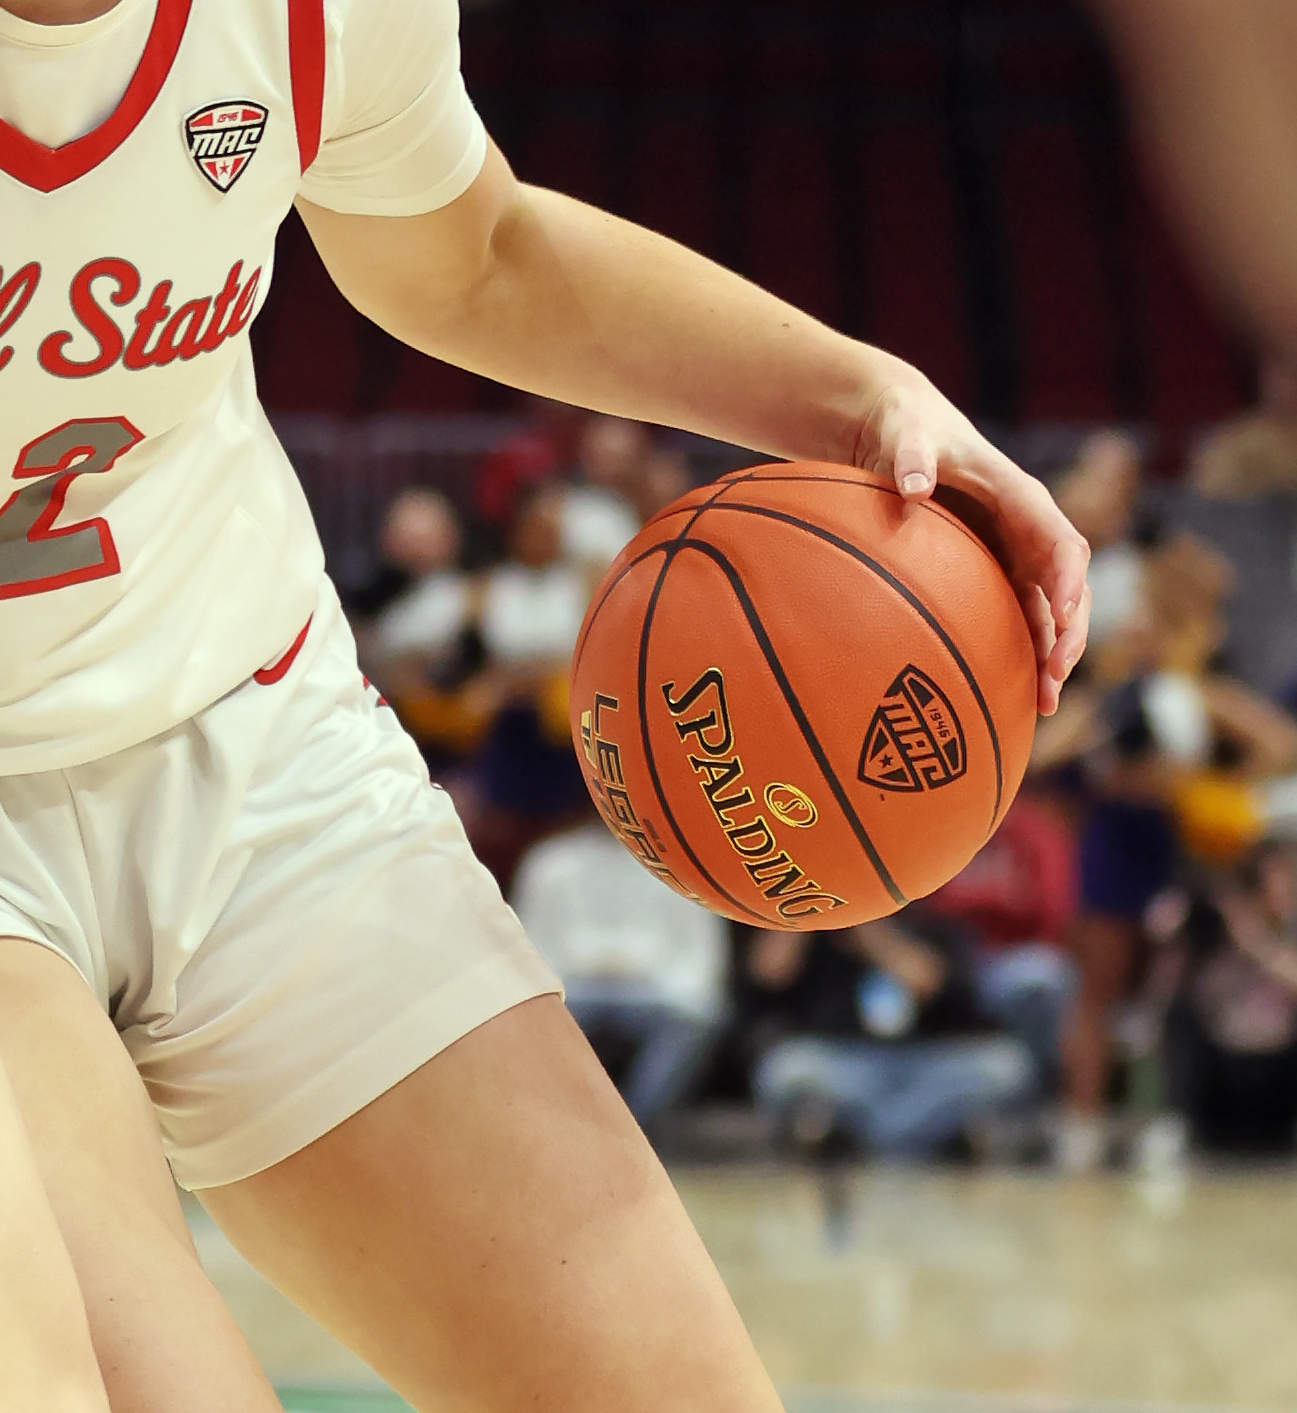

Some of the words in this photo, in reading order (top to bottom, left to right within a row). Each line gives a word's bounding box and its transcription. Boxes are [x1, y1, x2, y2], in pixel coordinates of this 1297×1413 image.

[192, 127, 262, 157] MAC
[38, 257, 262, 379] State
[879, 690, 948, 789] MAC
[927, 707, 952, 738] 1946
[661, 666, 849, 921] SPALDING
